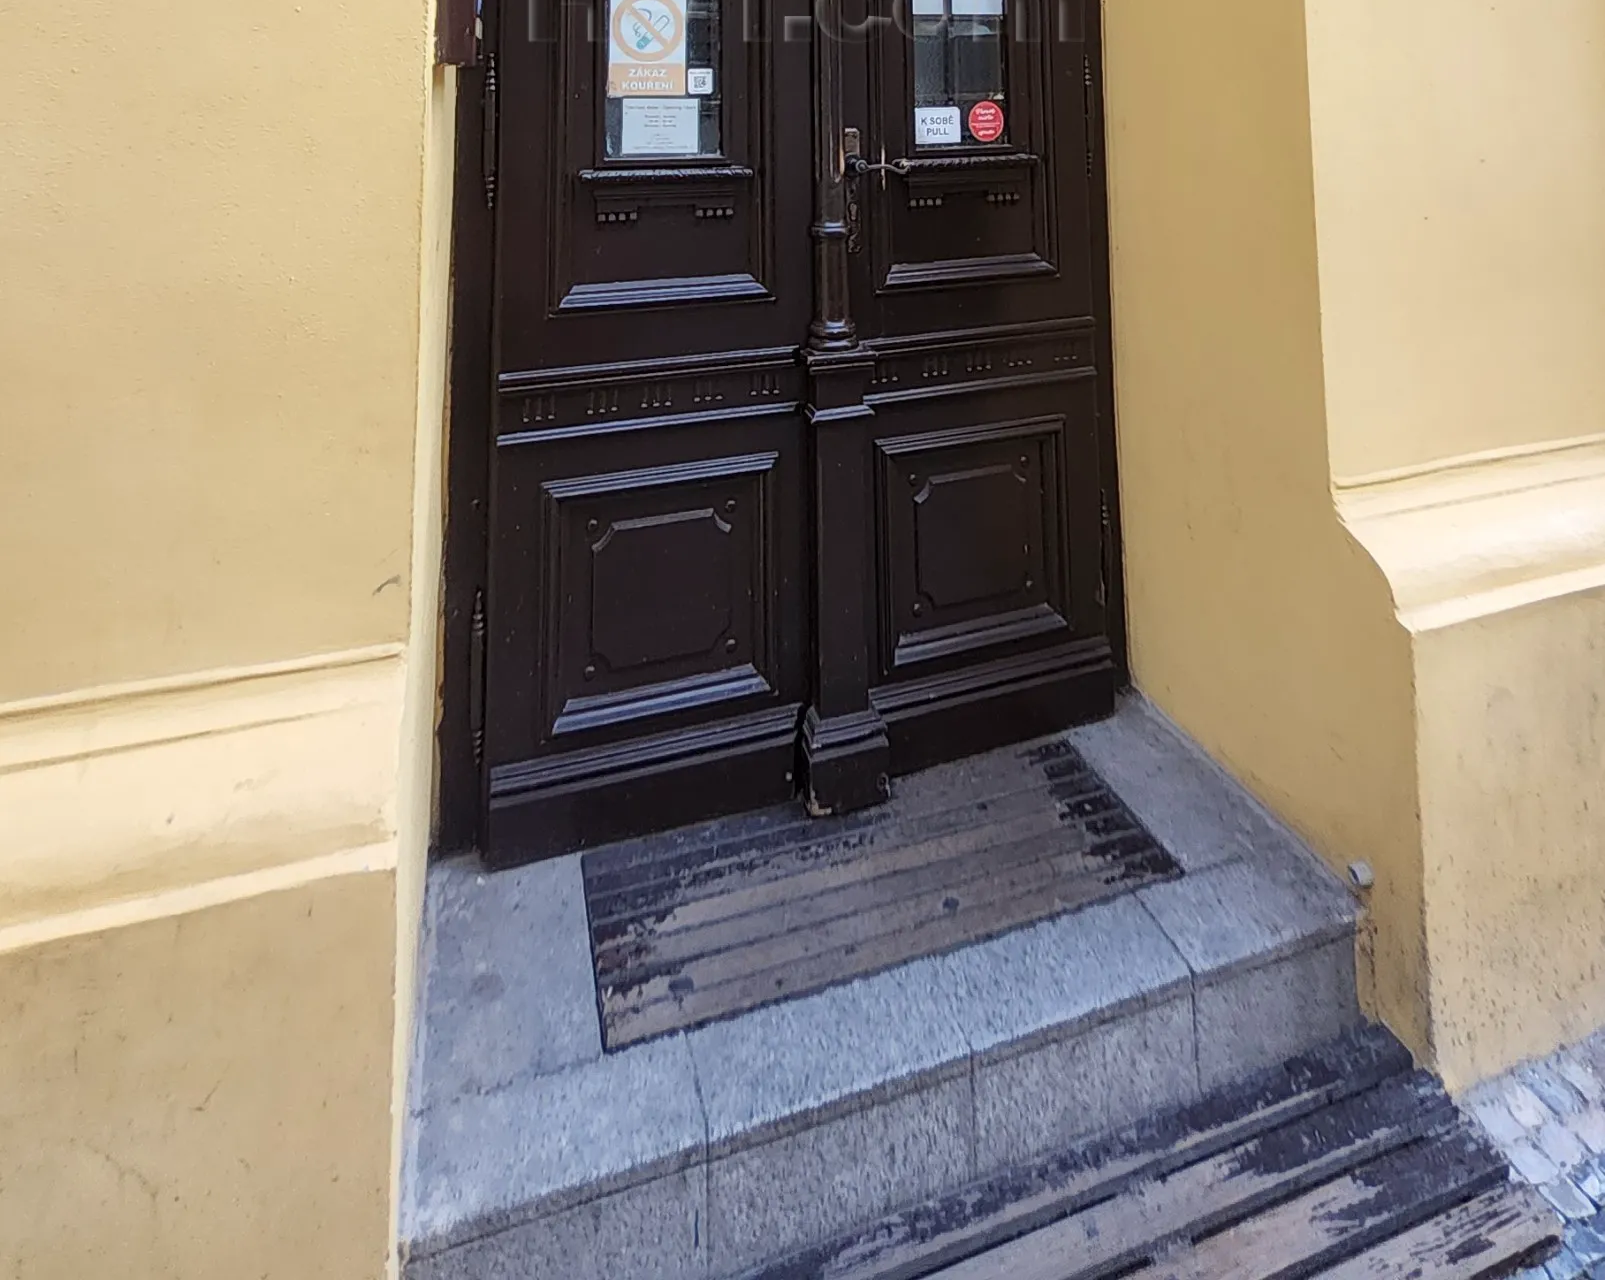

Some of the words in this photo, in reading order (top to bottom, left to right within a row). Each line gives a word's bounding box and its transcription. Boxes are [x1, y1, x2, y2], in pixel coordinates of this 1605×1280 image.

[628, 66, 667, 77] ZÁKAZ
[920, 117, 928, 125] K
[926, 127, 949, 136] PULL
